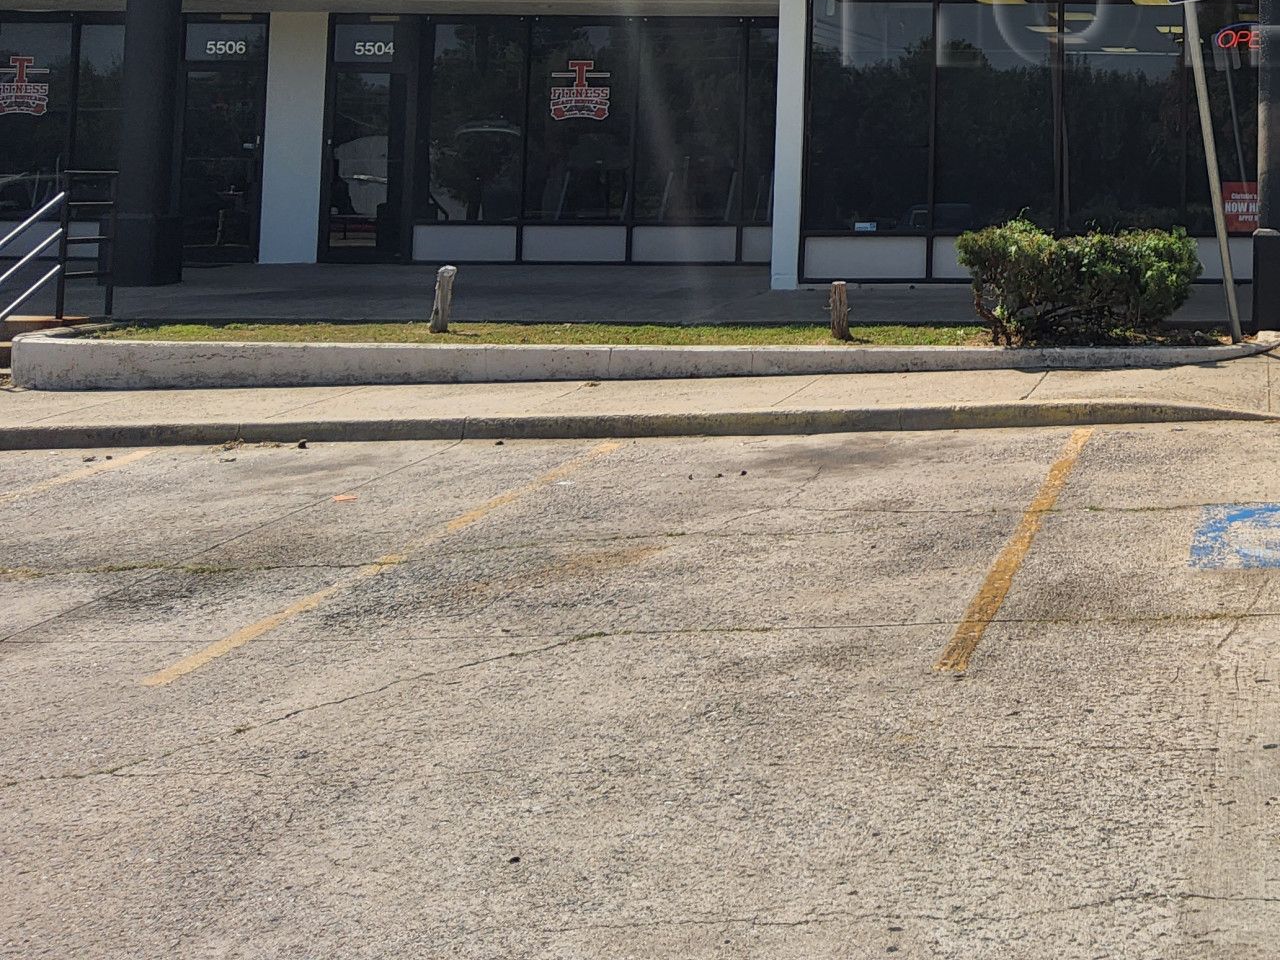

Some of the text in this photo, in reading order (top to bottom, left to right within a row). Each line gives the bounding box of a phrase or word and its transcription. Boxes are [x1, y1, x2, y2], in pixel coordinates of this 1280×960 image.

[205, 41, 246, 55] 5506
[354, 42, 395, 56] 5504
[551, 87, 610, 100] FITNESS
[1225, 201, 1247, 213] NOW
